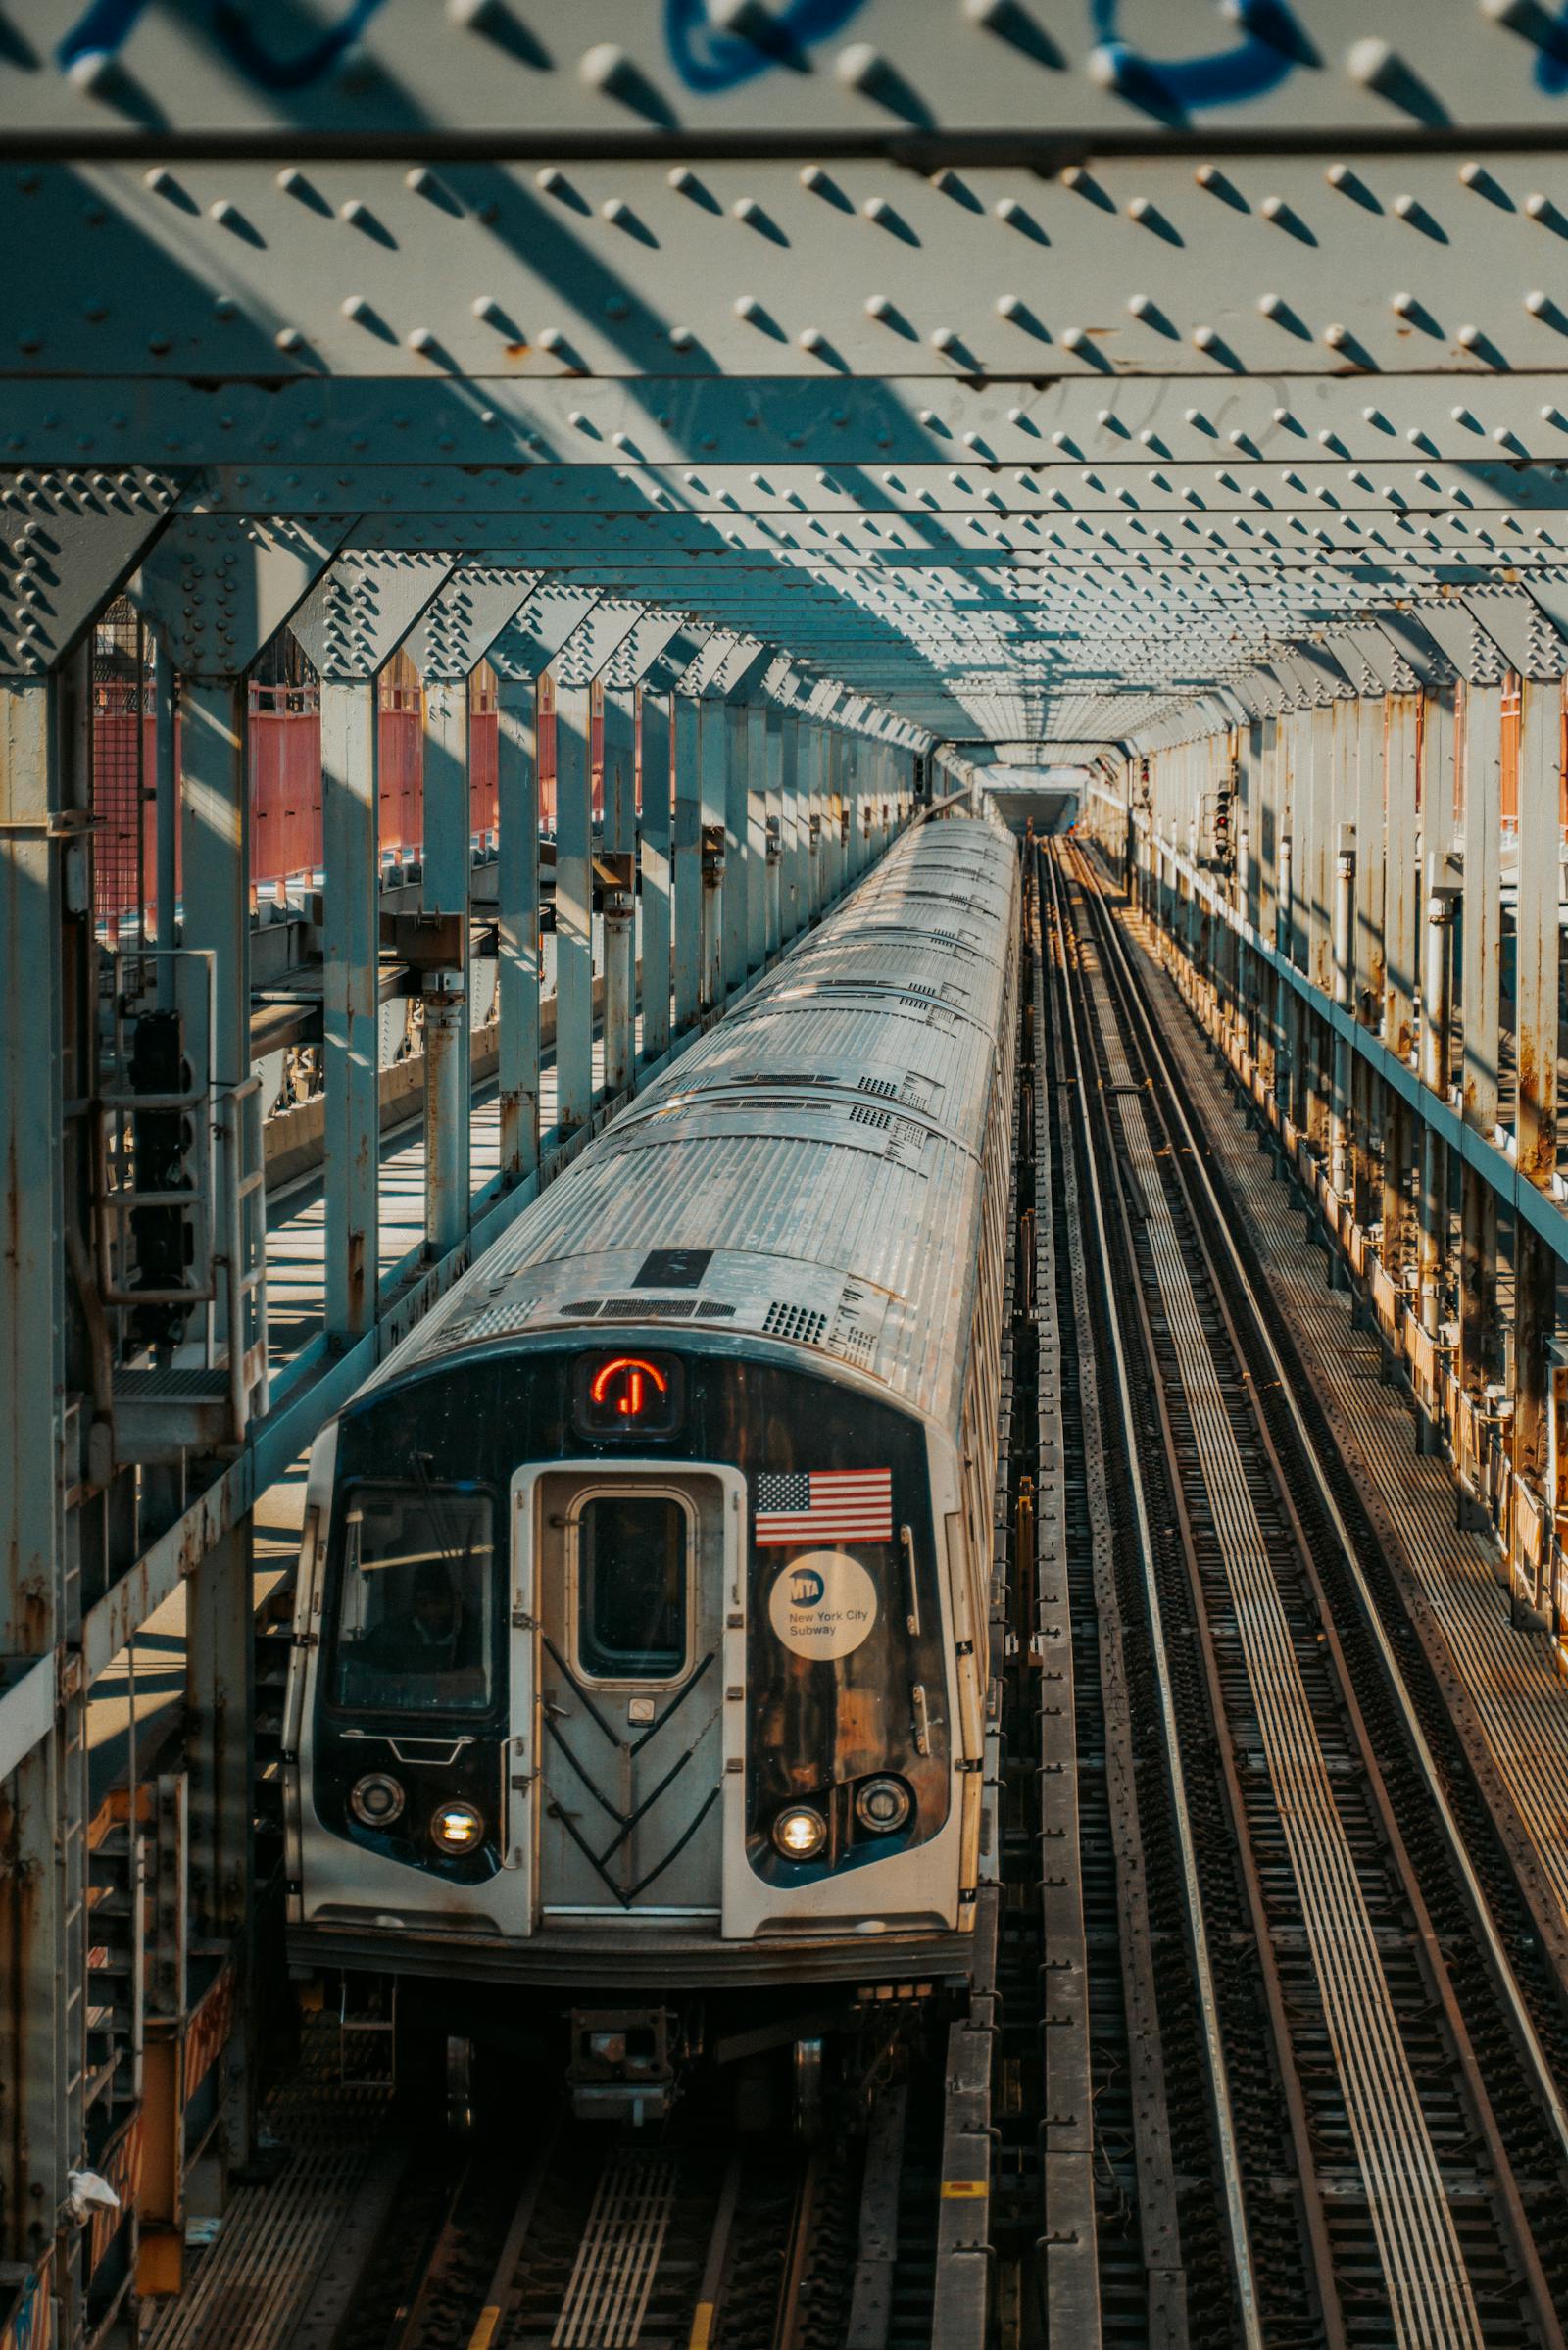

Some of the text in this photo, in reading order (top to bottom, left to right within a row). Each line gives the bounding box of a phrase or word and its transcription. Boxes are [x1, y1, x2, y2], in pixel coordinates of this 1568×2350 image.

[617, 1372, 644, 1415] J
[789, 1574, 820, 1602] MTA
[789, 1609, 868, 1623] New York City
[790, 1625, 836, 1636] Subway
